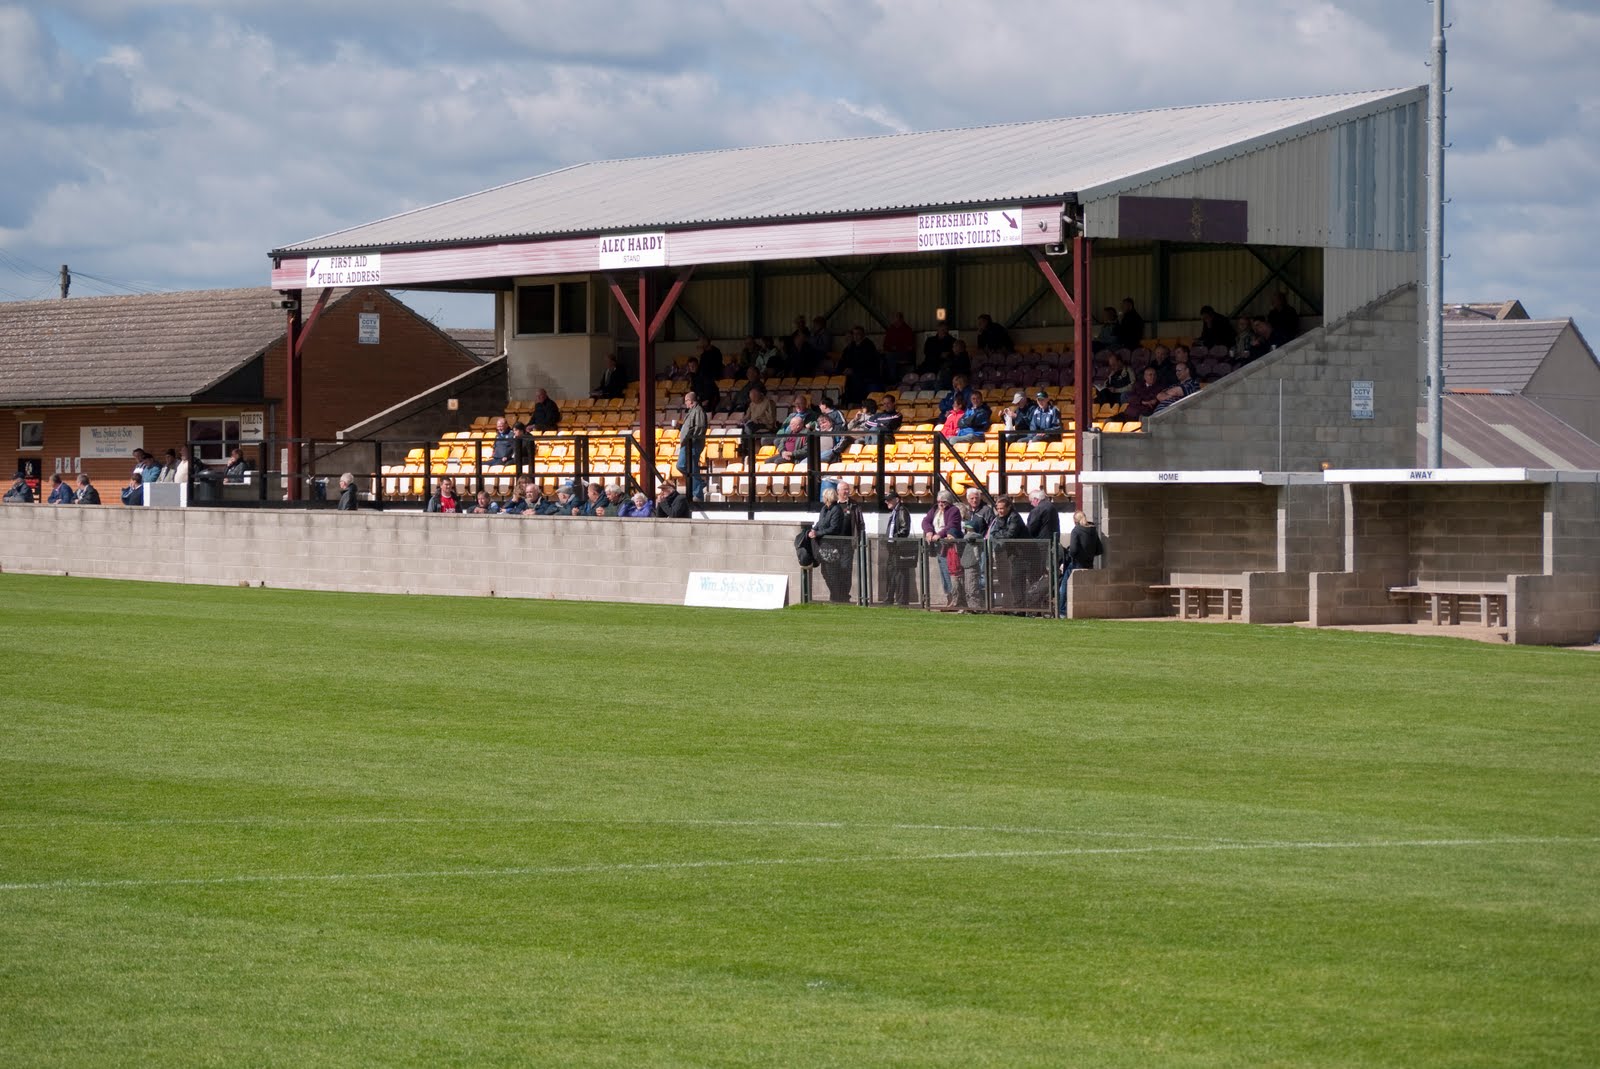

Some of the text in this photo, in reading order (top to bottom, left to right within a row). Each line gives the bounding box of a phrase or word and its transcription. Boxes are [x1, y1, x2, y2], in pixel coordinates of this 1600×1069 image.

[919, 212, 989, 229] REFRESHMENTS
[601, 235, 663, 253] ALEC HARDY
[330, 256, 368, 268] FIRST AID
[623, 254, 641, 263] STAND
[318, 270, 380, 284] PUBLIC ADDRESS
[242, 414, 262, 424] TOILETS
[1410, 470, 1432, 479] AWAY
